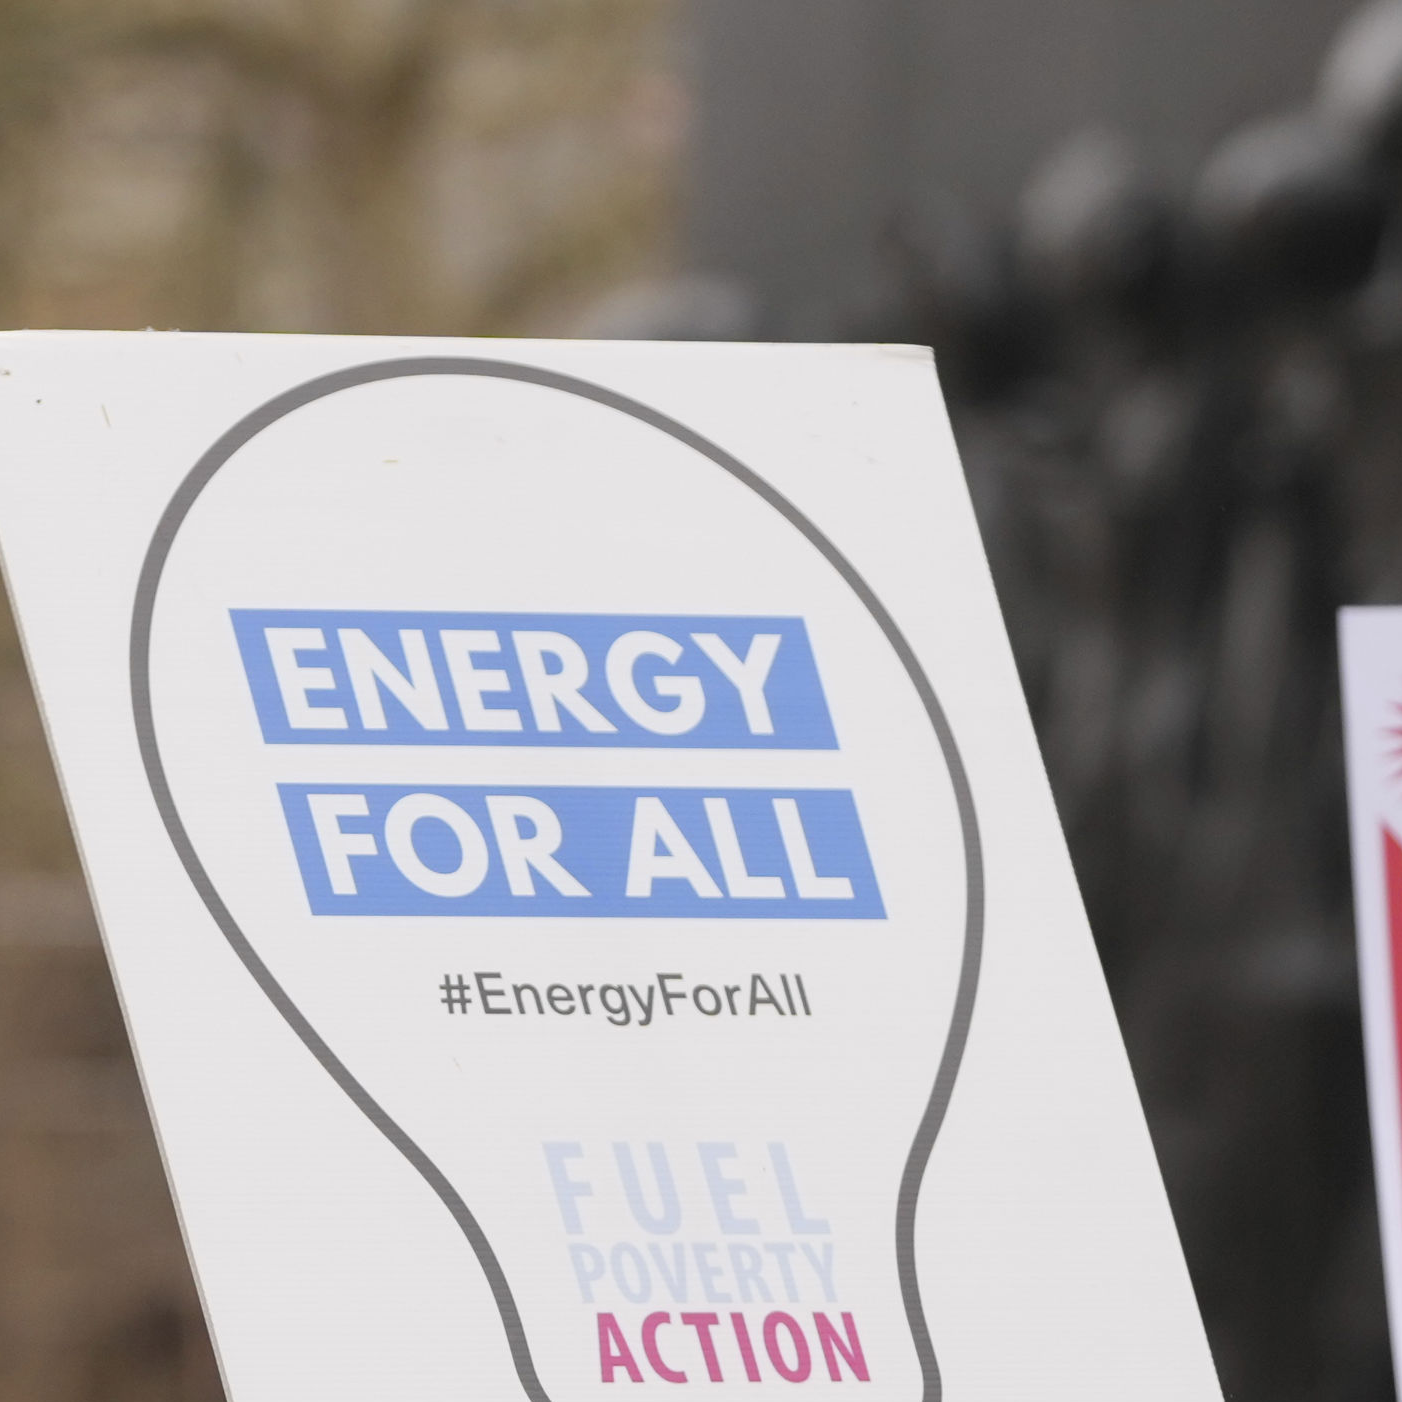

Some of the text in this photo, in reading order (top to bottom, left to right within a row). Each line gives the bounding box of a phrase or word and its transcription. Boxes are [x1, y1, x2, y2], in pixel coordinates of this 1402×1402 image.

[263, 627, 782, 736] ENERGY
[306, 792, 855, 900] FOR ALL
[439, 971, 812, 1026] #EnergyForAll
[542, 1141, 832, 1236] FUEL
[567, 1241, 838, 1304] POVERTY
[597, 1310, 871, 1384] ACTION
